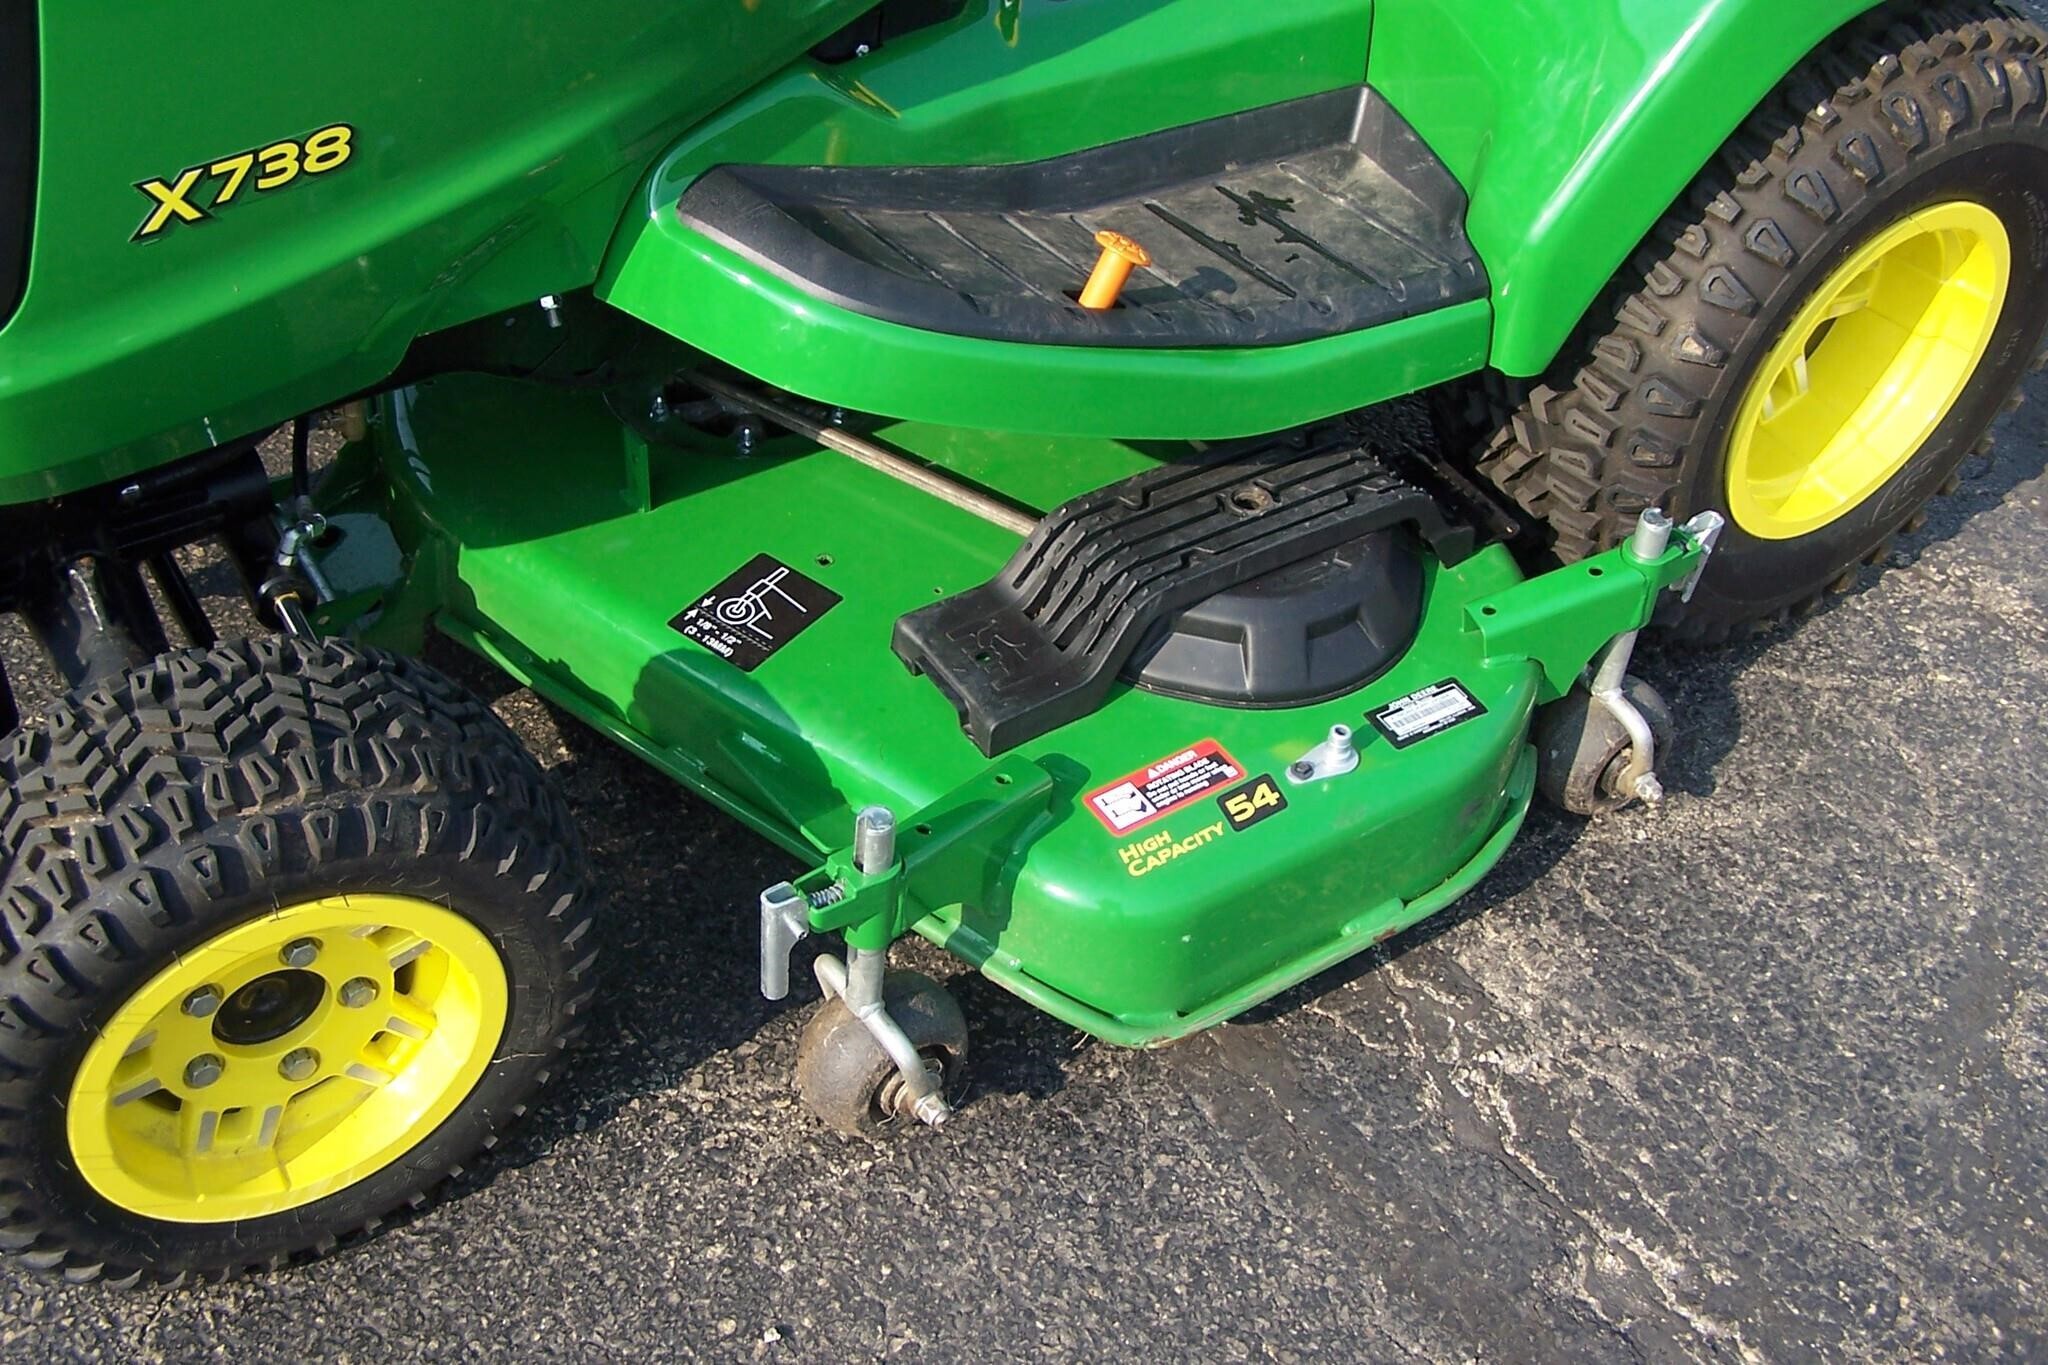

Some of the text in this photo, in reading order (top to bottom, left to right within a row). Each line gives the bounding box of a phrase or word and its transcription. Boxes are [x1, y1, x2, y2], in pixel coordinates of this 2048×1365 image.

[137, 124, 354, 237] X738
[1156, 749, 1198, 773] DANGER
[1225, 782, 1280, 823] 54
[1118, 830, 1172, 864] HIGH
[1128, 821, 1224, 877] CAPACITY
